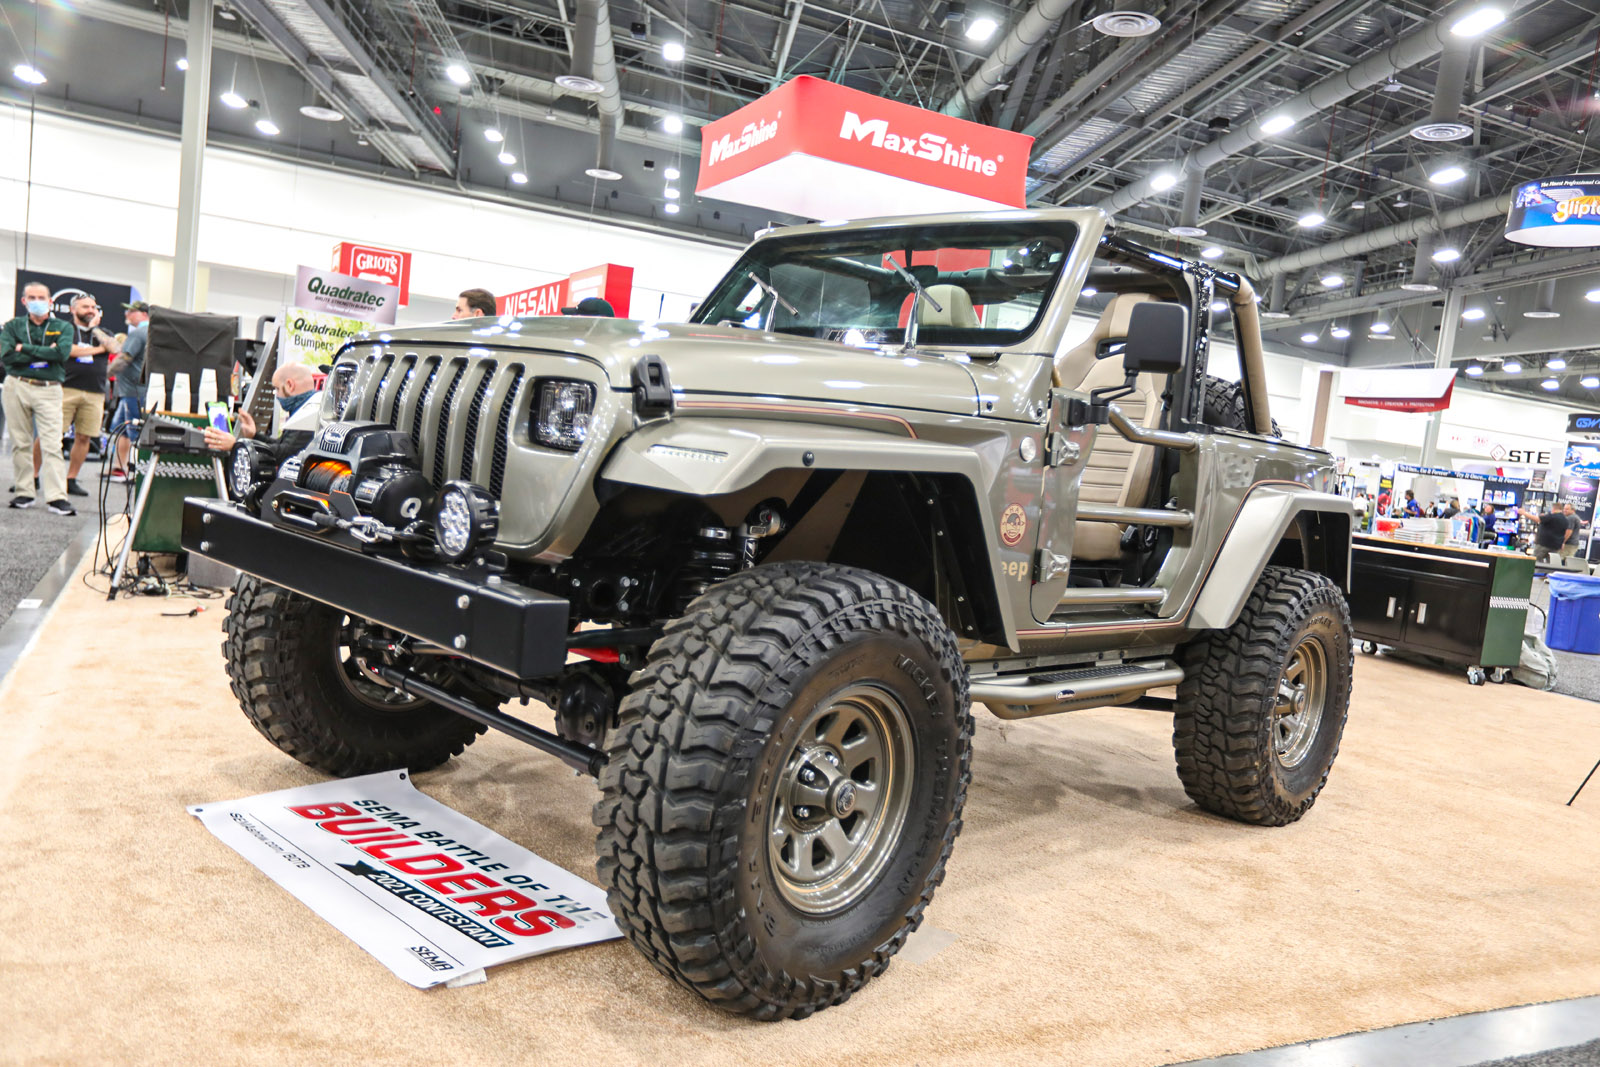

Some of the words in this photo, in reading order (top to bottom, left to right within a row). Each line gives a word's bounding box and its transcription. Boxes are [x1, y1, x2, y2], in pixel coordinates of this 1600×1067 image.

[708, 118, 778, 167] MaxShine
[839, 111, 998, 177] MaxShine
[356, 253, 398, 275] GRIOT'S
[308, 277, 385, 306] Quadratec
[504, 284, 560, 317] NISSAN
[294, 318, 355, 338] Quadratec
[294, 334, 335, 351] Bumpers
[400, 497, 422, 519] Q
[1001, 561, 1029, 581] eep
[286, 802, 577, 937] BUILDERS
[352, 799, 421, 830] SEMA
[414, 830, 510, 872] BATTLE
[503, 874, 550, 892] OF
[543, 894, 608, 922] THE
[368, 873, 409, 895] 2021
[404, 892, 511, 947] CONTESTANT
[410, 946, 455, 971] SEMA
